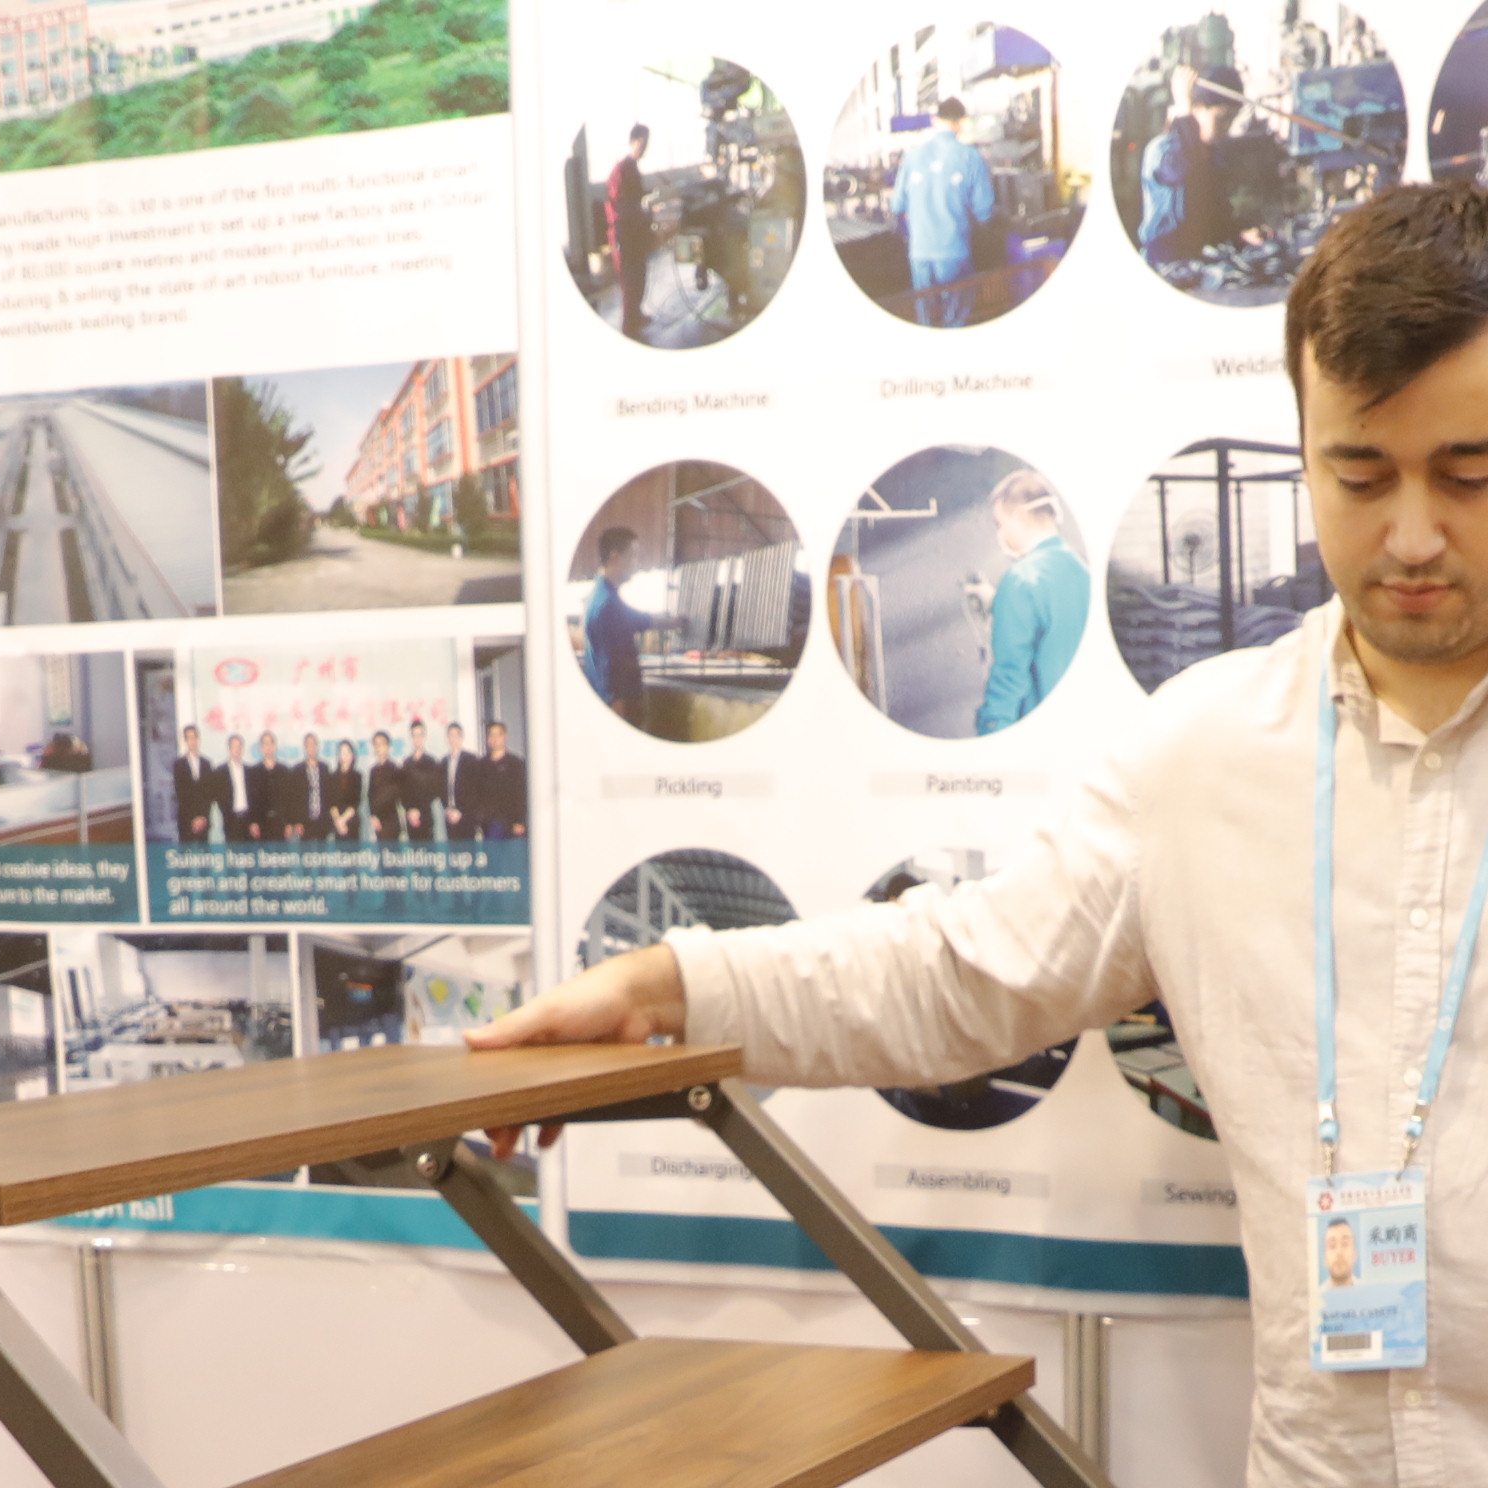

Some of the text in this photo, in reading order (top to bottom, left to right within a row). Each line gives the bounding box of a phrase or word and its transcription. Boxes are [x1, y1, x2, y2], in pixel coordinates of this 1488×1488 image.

[232, 184, 257, 202] the
[21, 234, 60, 253] made
[67, 230, 100, 252] huge
[108, 220, 194, 244] investment
[292, 210, 320, 224] new
[127, 282, 150, 299] the
[1212, 355, 1286, 376] Weldin
[881, 373, 1034, 399] Drilling Machine
[616, 392, 770, 417] Bending Machine
[654, 775, 723, 799] Pickling
[925, 773, 1003, 797] Painting
[96, 858, 129, 883] they
[165, 847, 488, 873] Suixing has been constantly building up a
[17, 885, 32, 904] to
[32, 884, 59, 904] the
[167, 871, 521, 897] green and creative smart home for customers
[168, 895, 328, 916] all around the world.
[906, 1168, 1012, 1197] Assembling
[1164, 1182, 1237, 1208] Sewing
[1370, 1248, 1417, 1267] BUYER
